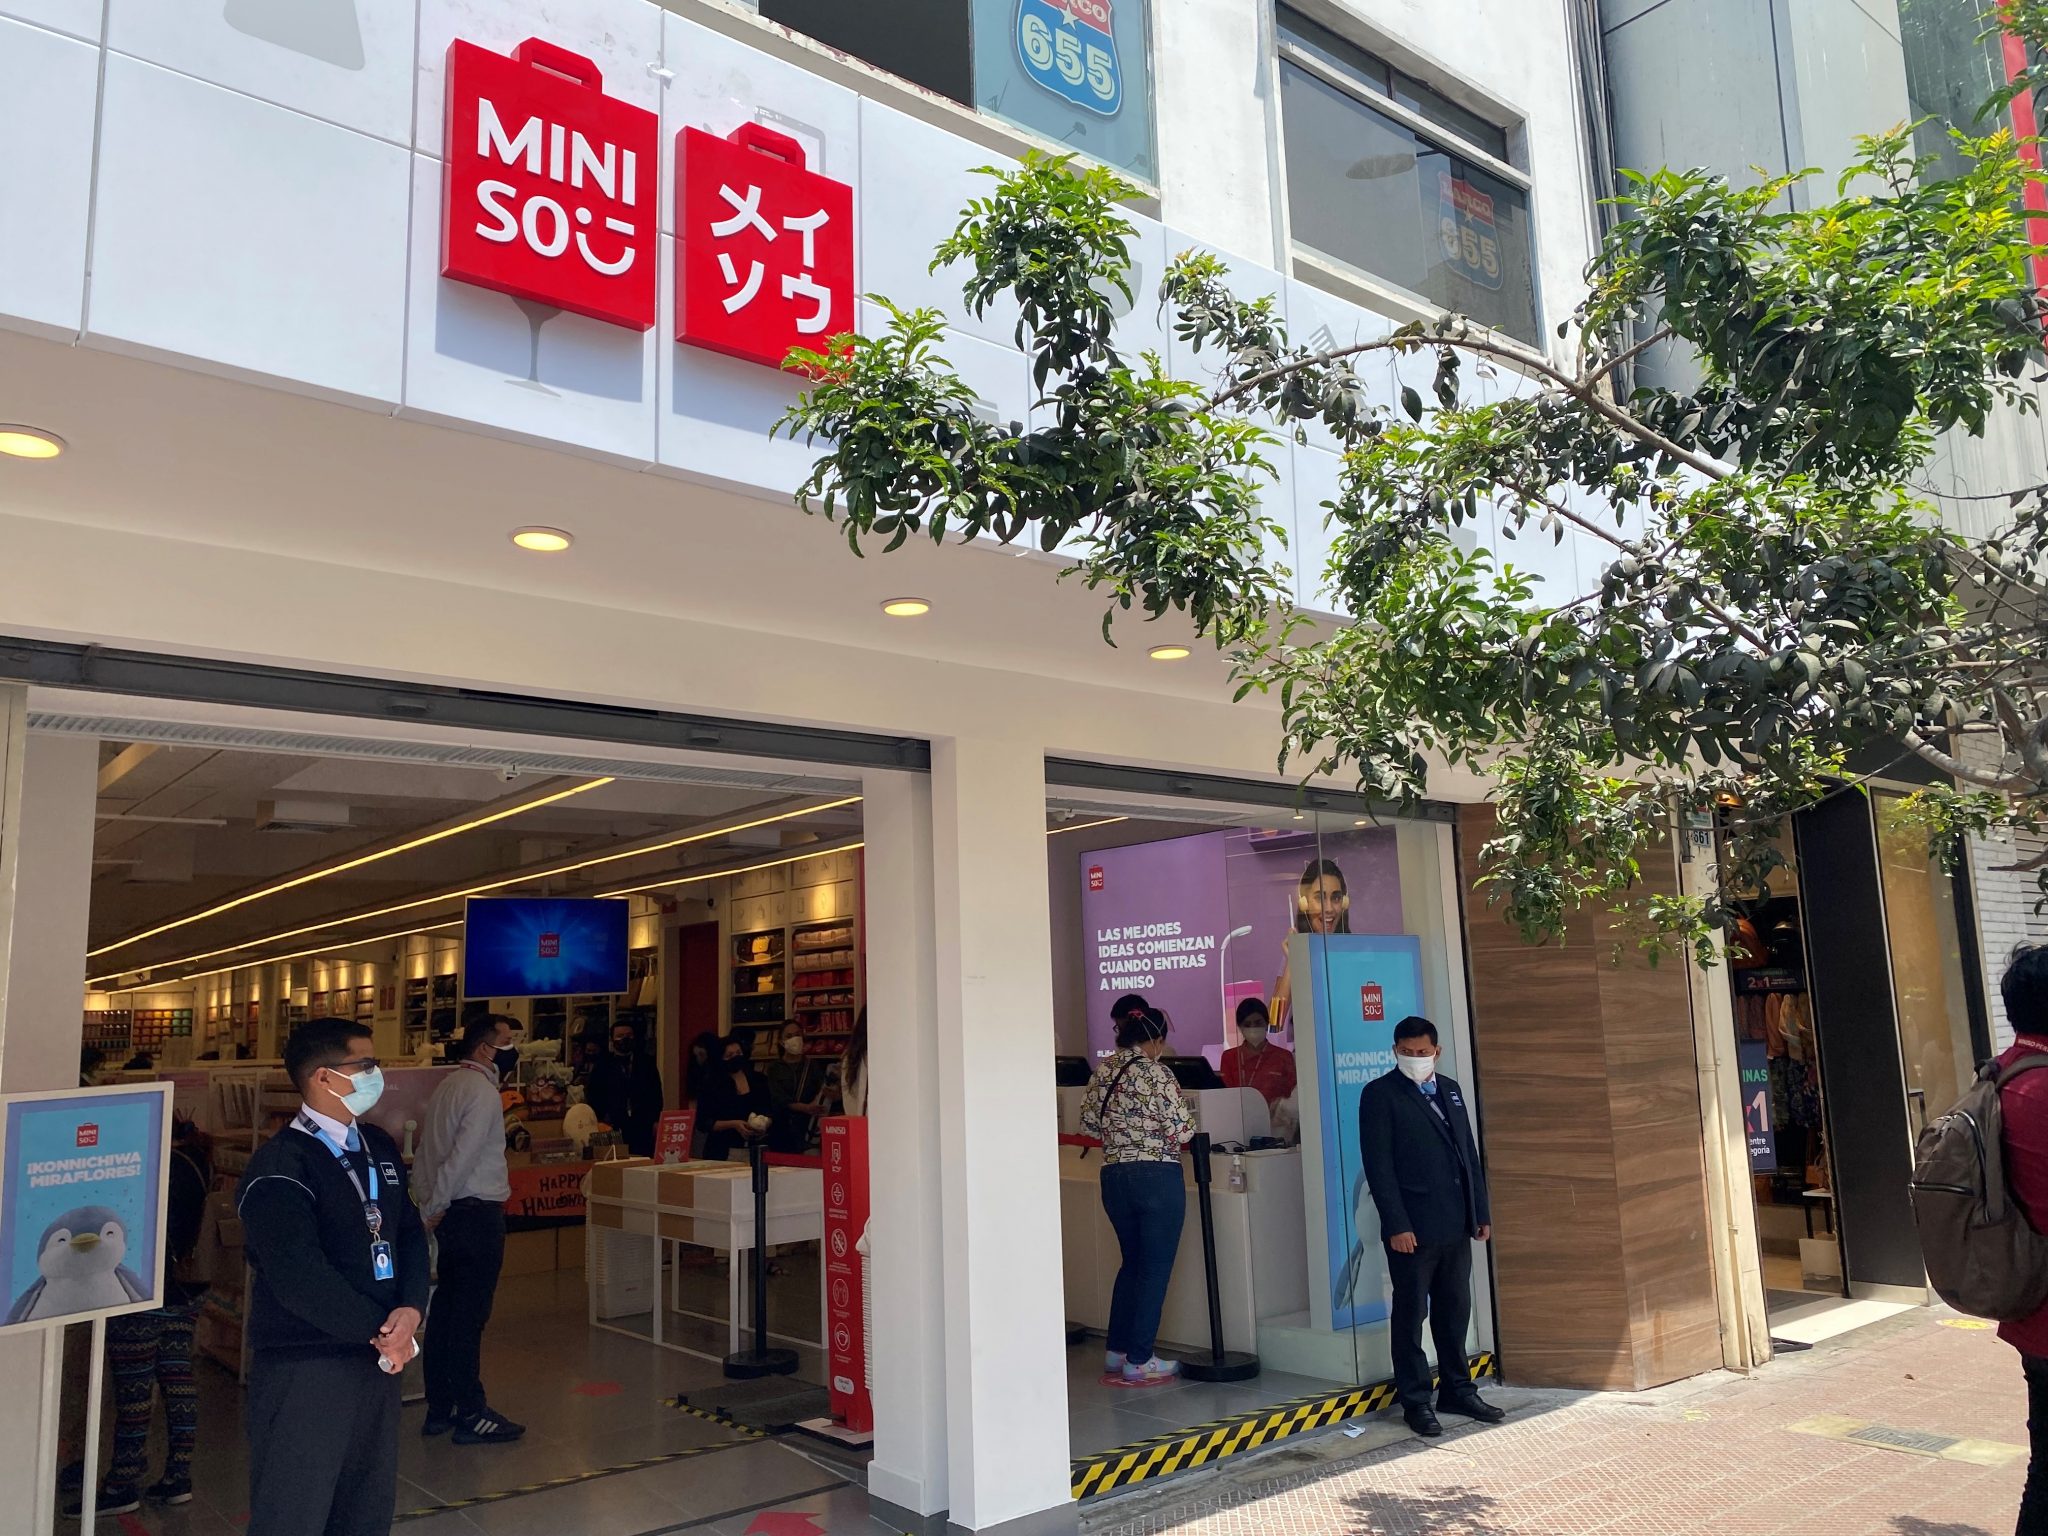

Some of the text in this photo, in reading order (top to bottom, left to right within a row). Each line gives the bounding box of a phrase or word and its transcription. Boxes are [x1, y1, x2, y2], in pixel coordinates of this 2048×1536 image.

[1022, 14, 1116, 101] 655
[476, 97, 637, 207] MINI
[1441, 217, 1499, 279] 655
[1098, 922, 1181, 942] LAS MEJORES
[1098, 936, 1215, 958] IDEAS COMIENZAN
[1099, 954, 1207, 974] CUANDO ENTRAS
[1100, 975, 1155, 991] A MINISO
[1363, 994, 1381, 1003] MINI
[30, 1165, 141, 1188] MIRAFLORES!
[540, 1173, 585, 1192] HAPPY
